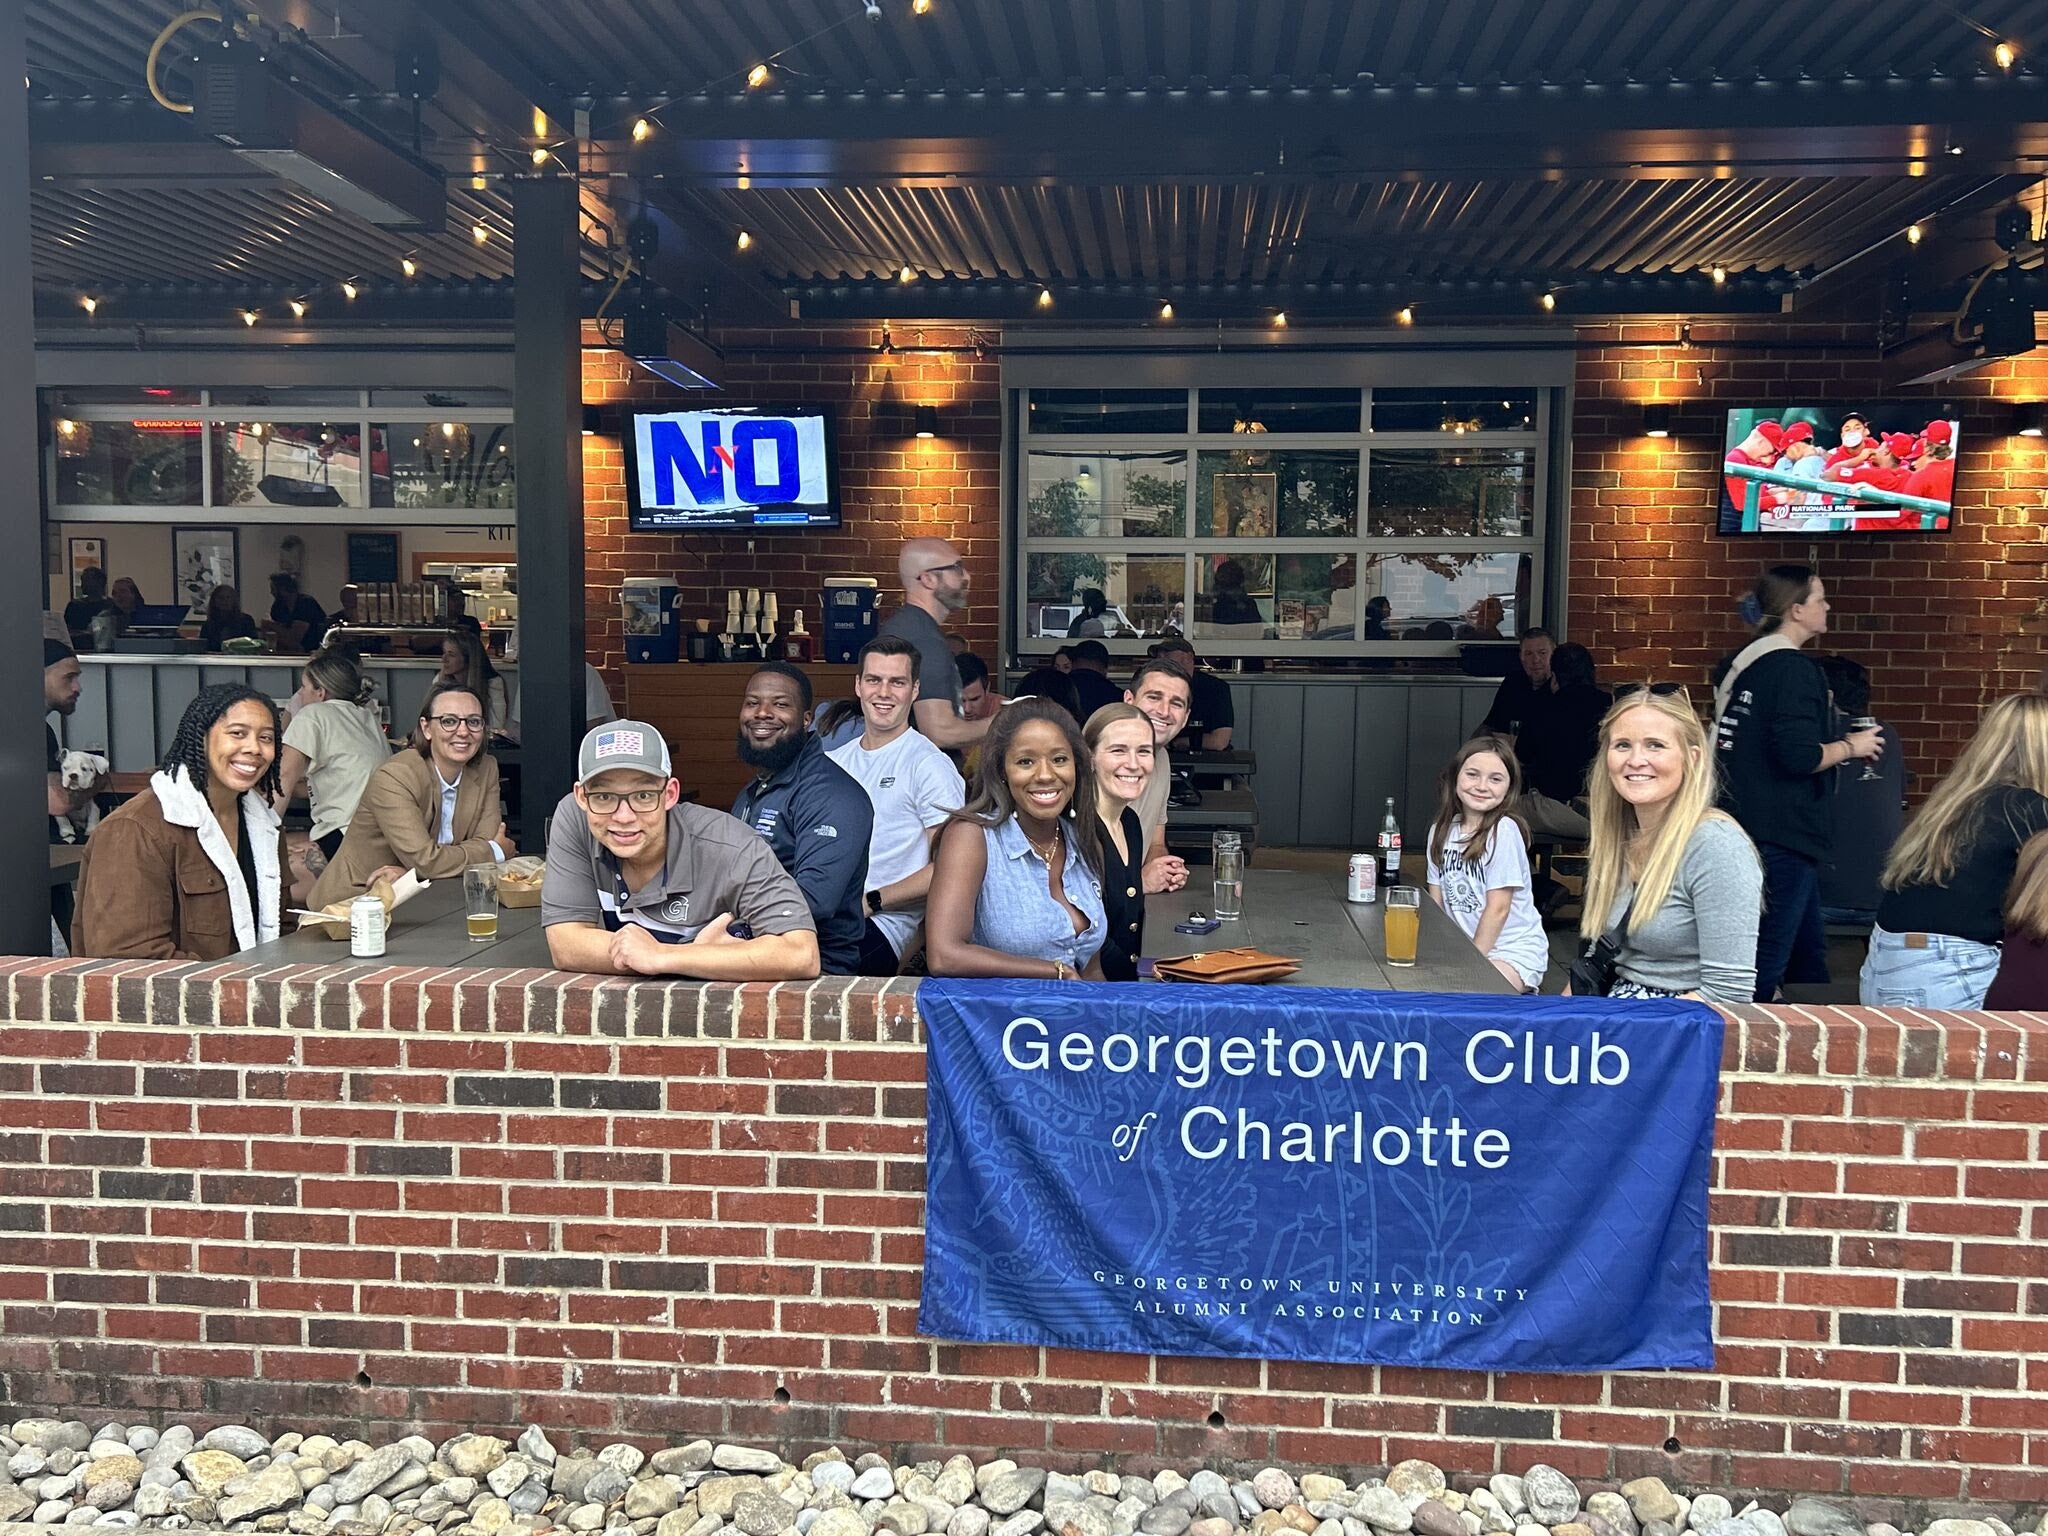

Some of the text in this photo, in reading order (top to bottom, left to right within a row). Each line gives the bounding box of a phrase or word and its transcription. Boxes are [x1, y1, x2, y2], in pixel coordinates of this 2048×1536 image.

[651, 419, 800, 506] NO
[661, 895, 689, 922] G
[1003, 1017, 1631, 1089] Georgetown Club
[1111, 1105, 1511, 1170] of Charlotte
[1093, 1270, 1529, 1301] GEORGETOWN UNIVERSITY
[1134, 1300, 1484, 1325] ALUMNI ASSOCIATION
